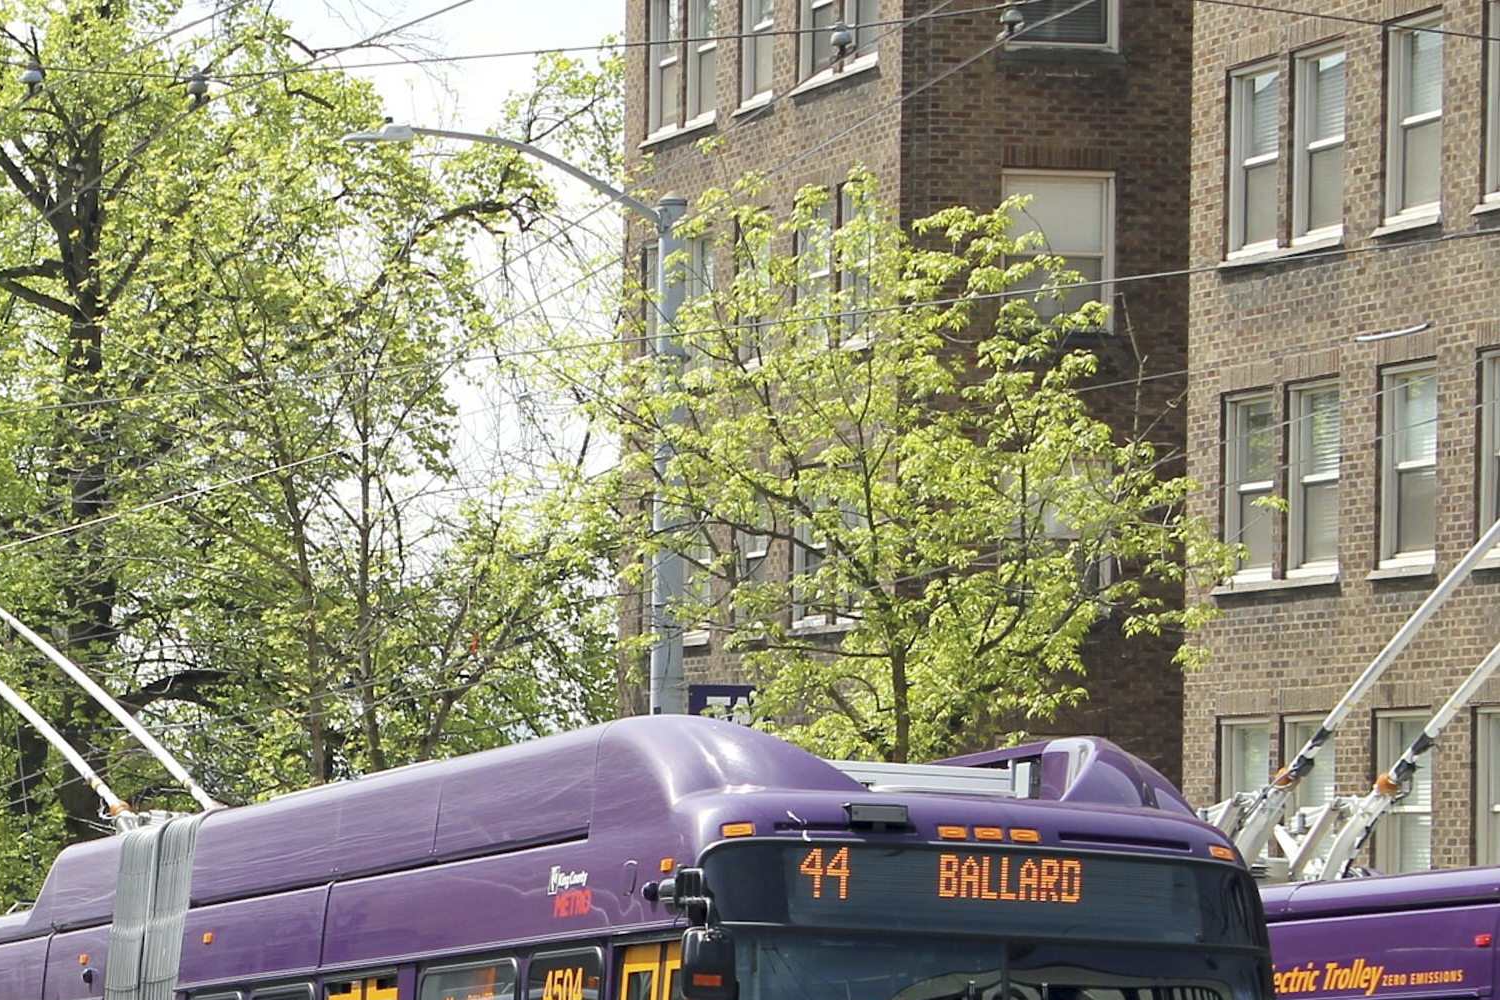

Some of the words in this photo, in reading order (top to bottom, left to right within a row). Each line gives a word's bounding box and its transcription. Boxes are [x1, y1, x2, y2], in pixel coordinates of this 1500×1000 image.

[800, 846, 850, 899] 44
[938, 853, 1081, 903] BALLARD
[554, 888, 592, 918] METRO
[1272, 962, 1320, 993] ectric
[1323, 958, 1384, 996] Trolley
[1382, 973, 1406, 987] ZERO
[1410, 969, 1464, 985] EMISSIONS
